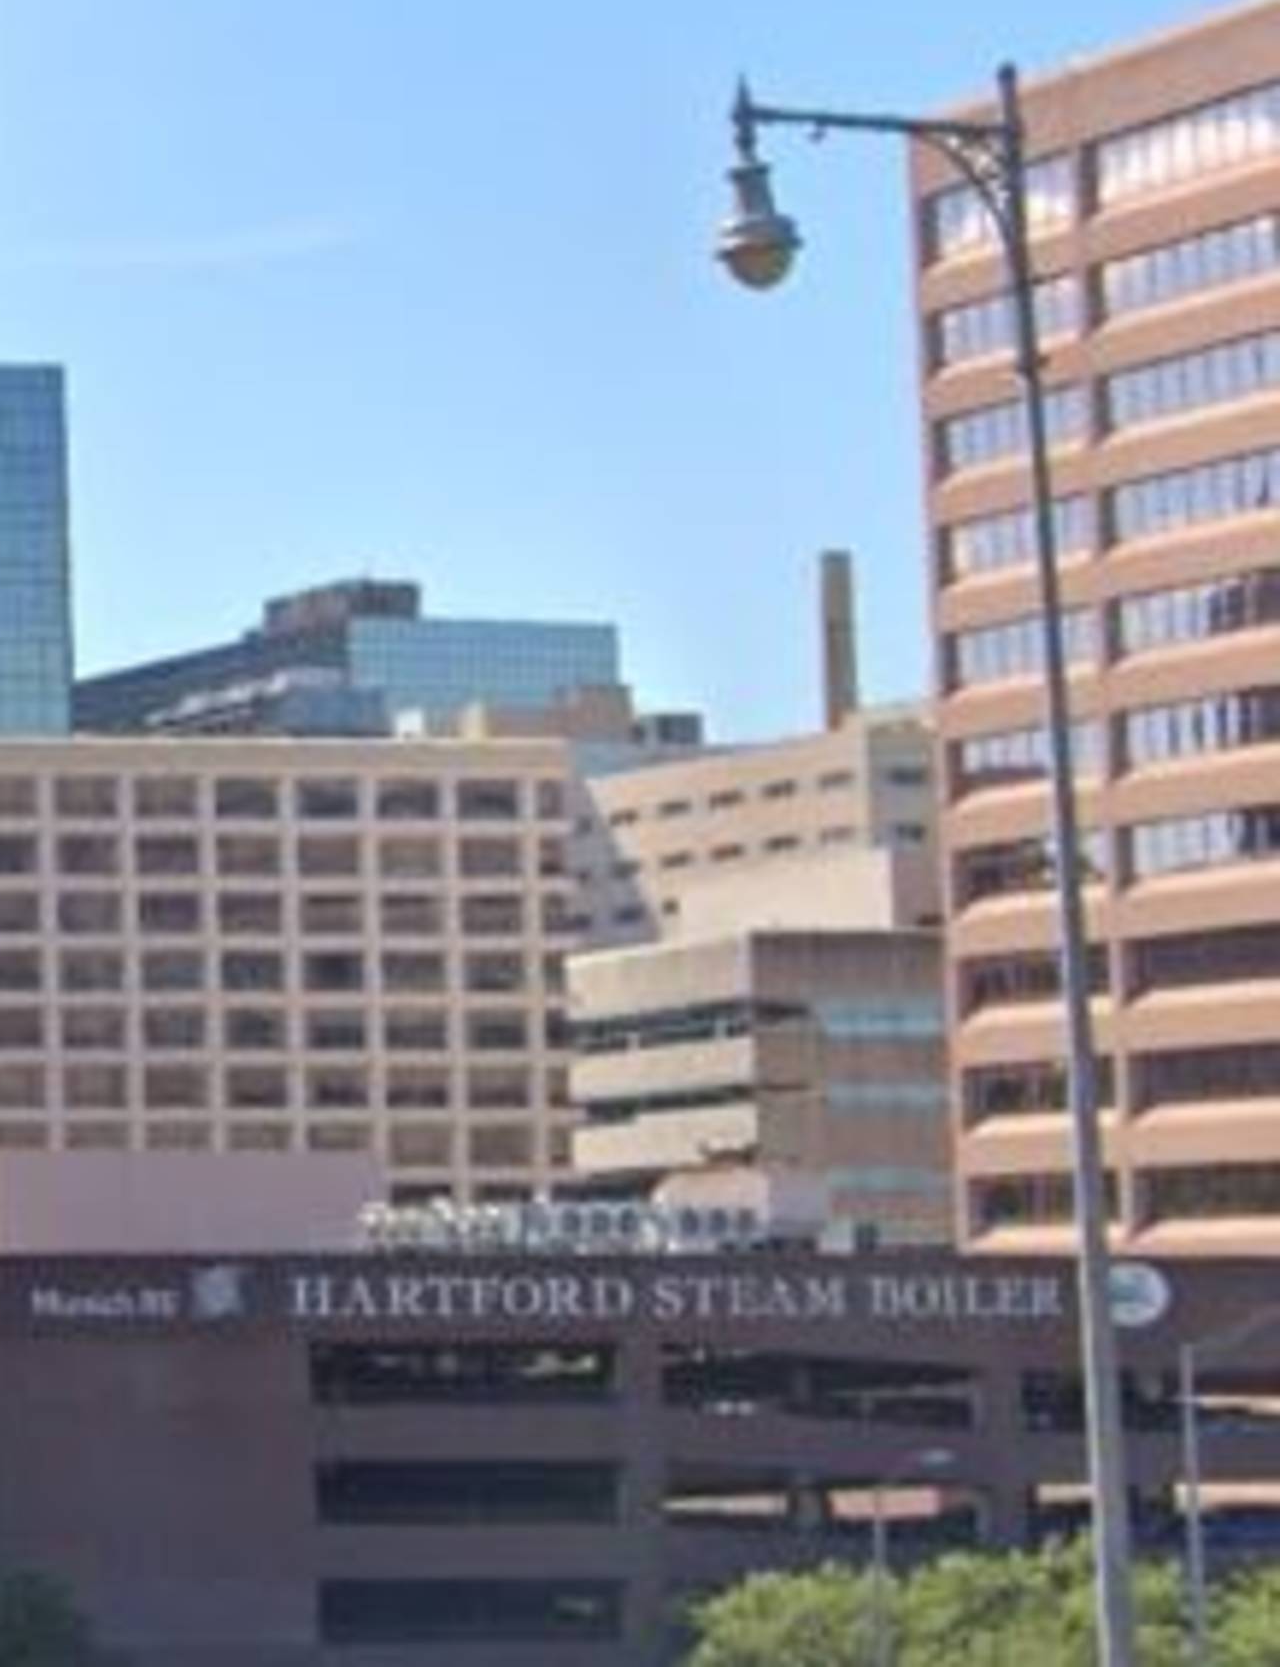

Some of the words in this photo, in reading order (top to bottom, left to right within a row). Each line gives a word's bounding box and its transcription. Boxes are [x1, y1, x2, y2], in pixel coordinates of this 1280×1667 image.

[290, 1274, 635, 1317] HARTFORD
[651, 1276, 847, 1318] STEAM
[871, 1277, 1064, 1318] BOILER
